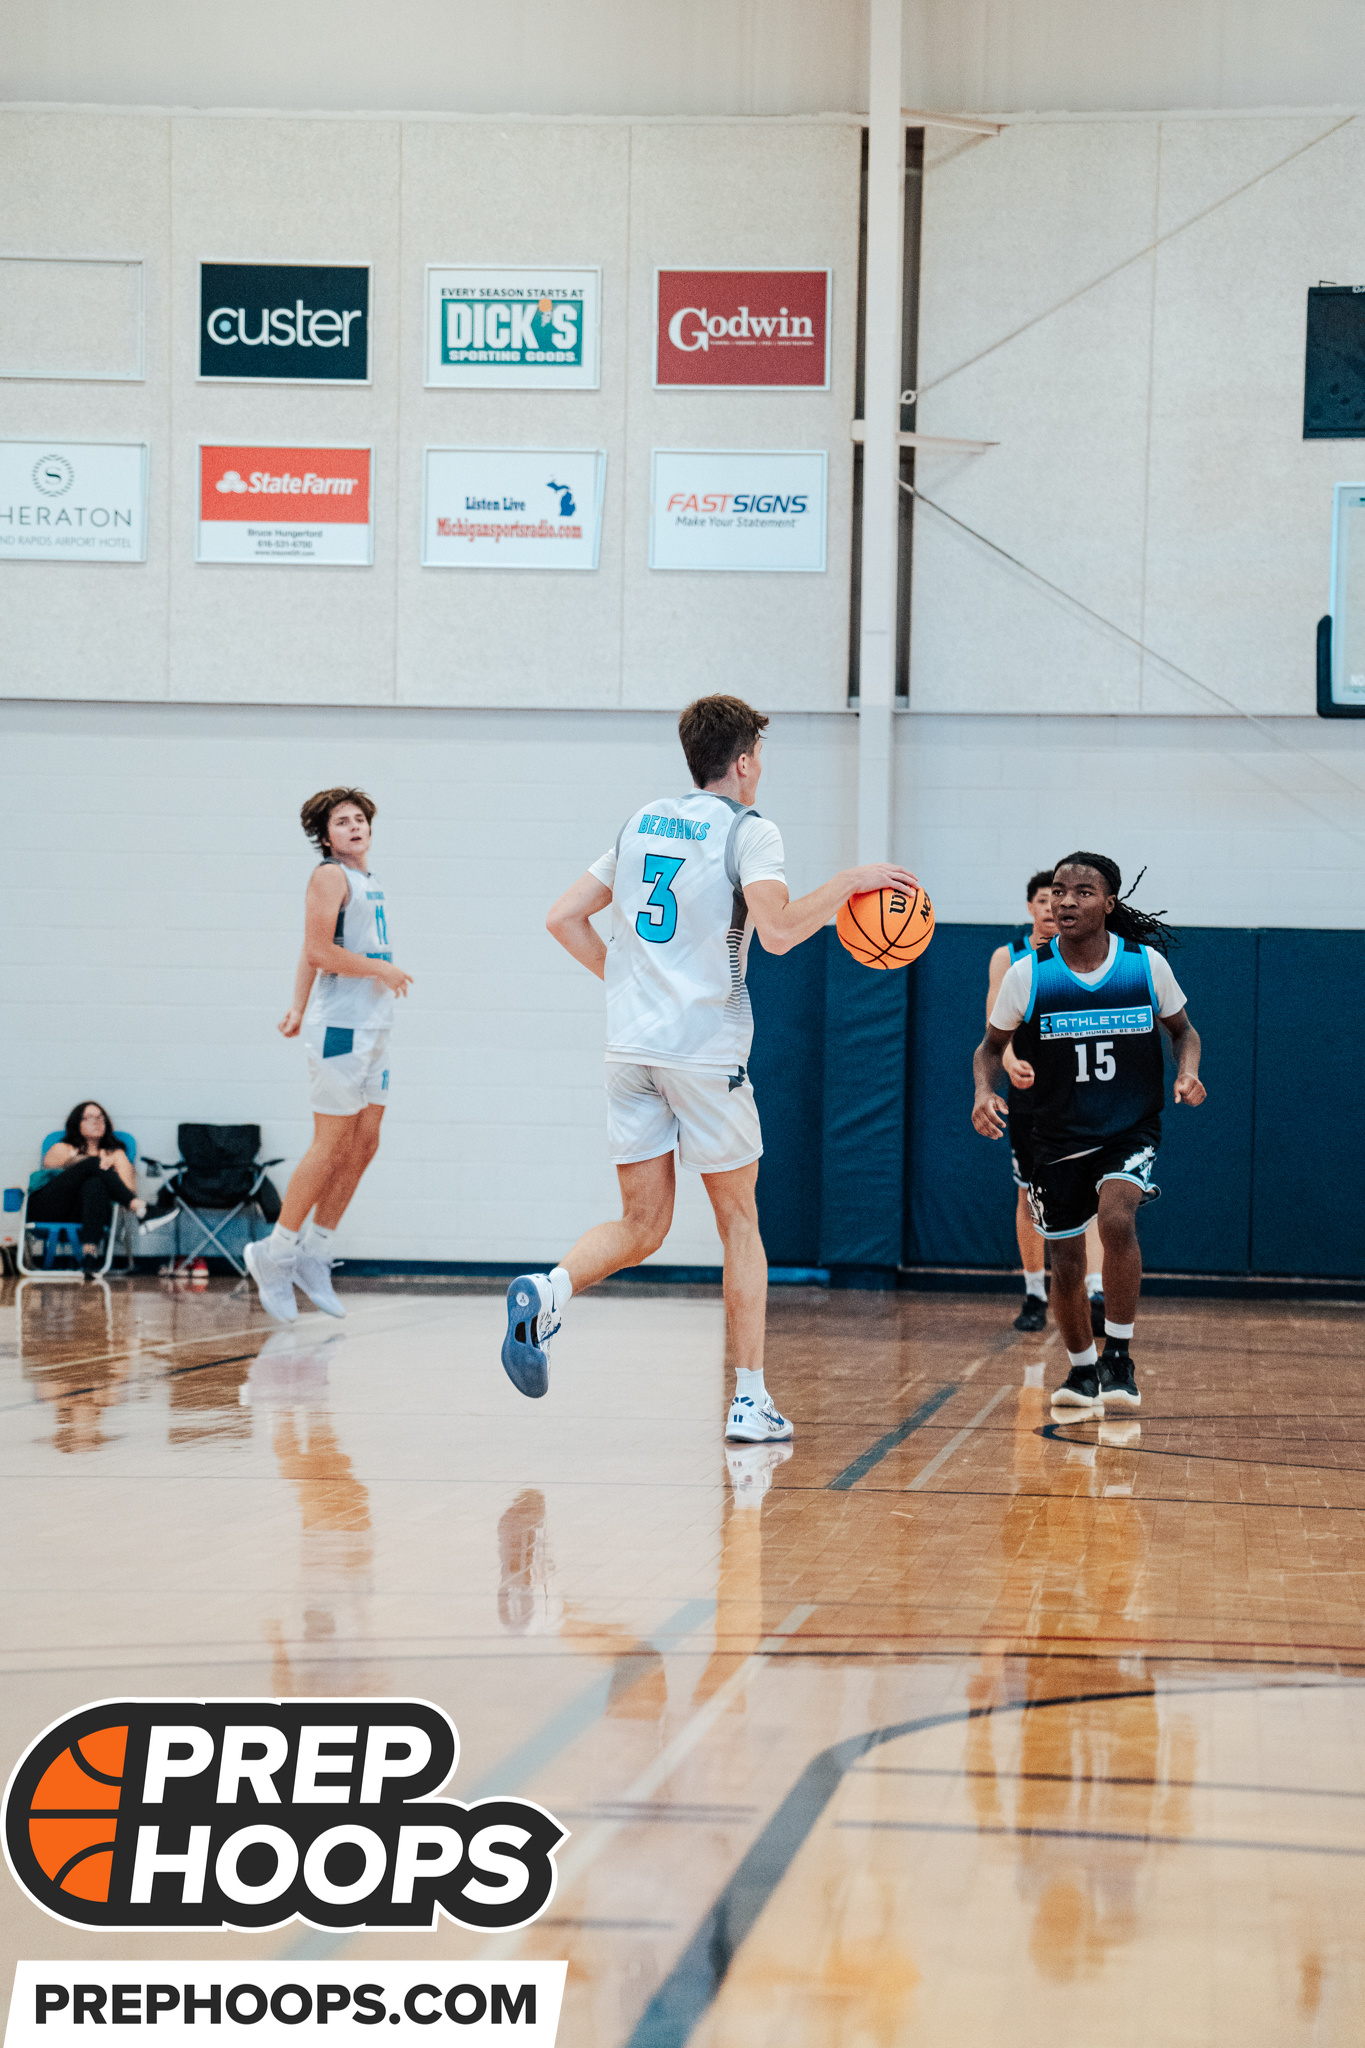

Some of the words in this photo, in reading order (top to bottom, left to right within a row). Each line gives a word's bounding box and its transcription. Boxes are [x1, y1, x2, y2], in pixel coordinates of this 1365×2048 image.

[441, 288, 475, 297] EVERY
[480, 289, 523, 297] SEASON
[527, 289, 567, 297] STARTS
[207, 300, 361, 347] custer
[447, 302, 578, 350] DICK'S
[668, 306, 815, 351] Godwin
[449, 350, 521, 362] SPORTING
[525, 351, 575, 362] GOODS
[465, 497, 500, 510] Listen
[503, 498, 526, 511] Live
[437, 518, 582, 543] Michigansportsradio.com
[675, 516, 706, 527] Make
[710, 517, 733, 527] Your
[737, 517, 796, 528] Statement
[18, 536, 52, 546] RAPIDS
[55, 537, 96, 547] AIRPORT
[99, 538, 131, 548] HOTEL
[637, 814, 711, 841] BERGHUIS
[635, 853, 686, 944] 3
[375, 905, 388, 945] 11
[1056, 1013, 1148, 1029] ATHLETICS
[1074, 1041, 1117, 1083] 15
